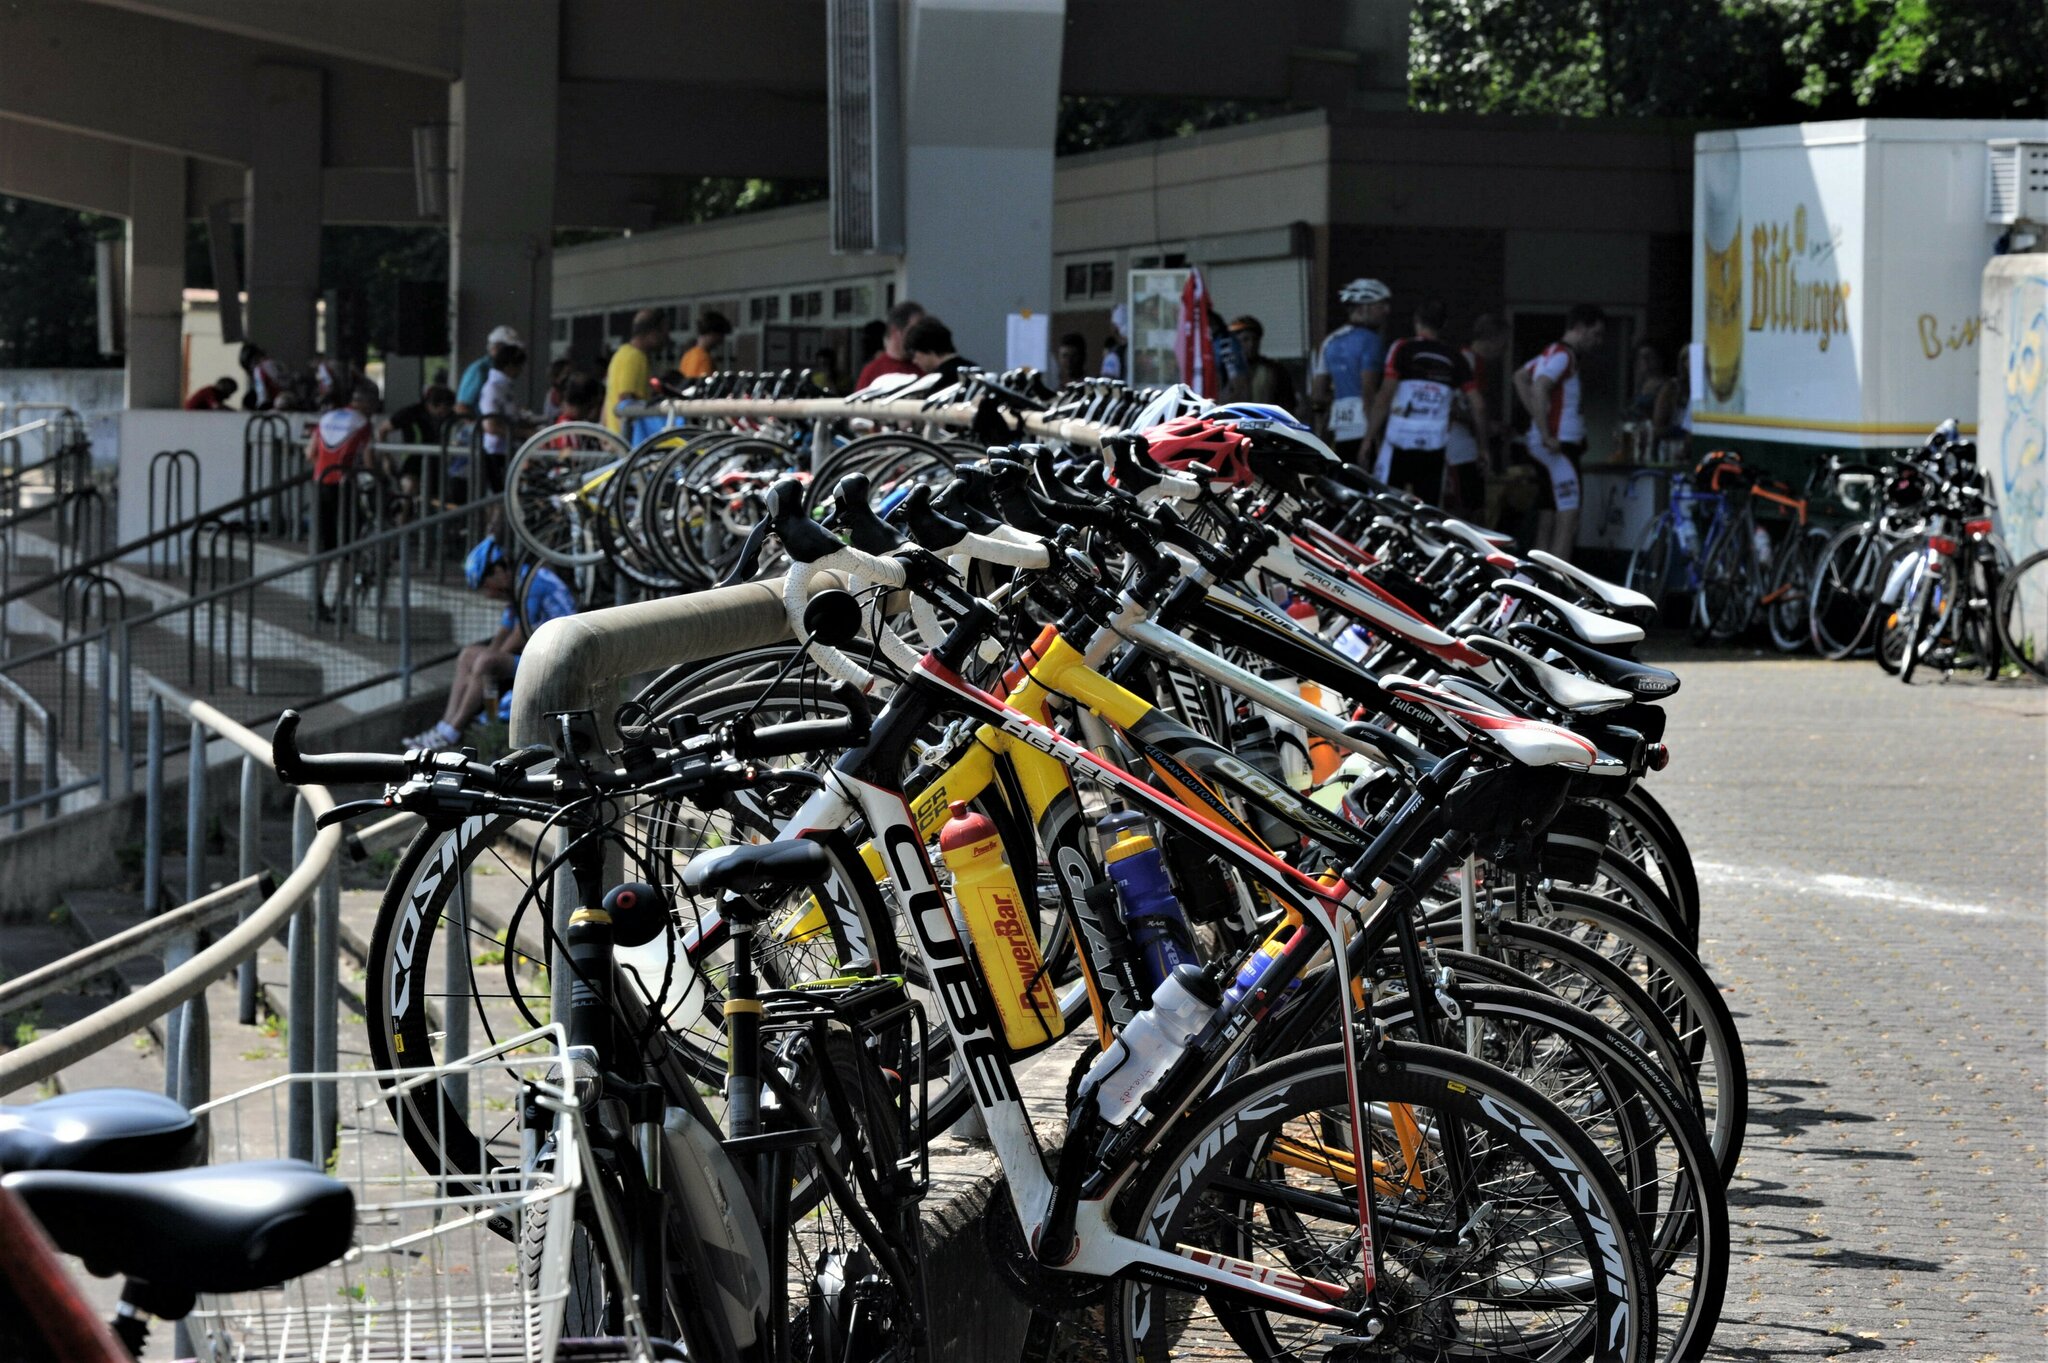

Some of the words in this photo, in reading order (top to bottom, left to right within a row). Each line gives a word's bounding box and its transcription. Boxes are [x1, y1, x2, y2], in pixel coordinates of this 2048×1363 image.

[1390, 697, 1436, 724] Fulcrum
[1001, 709, 1119, 790] AGREE
[912, 786, 947, 824] CR
[1144, 745, 1183, 778] GERMAN
[1180, 775, 1216, 811] CUSTOM
[1214, 804, 1241, 827] BIKES
[1215, 757, 1303, 815] OCR
[1306, 806, 1342, 832] COMPACT
[1345, 831, 1367, 847] ROAD
[885, 824, 1020, 1108] CUBE
[993, 893, 1050, 1010] PowerBar
[1614, 1039, 1674, 1100] CONTINENTAL
[1048, 1185, 1060, 1216] SHIMANO
[1362, 1223, 1376, 1279] CUBE
